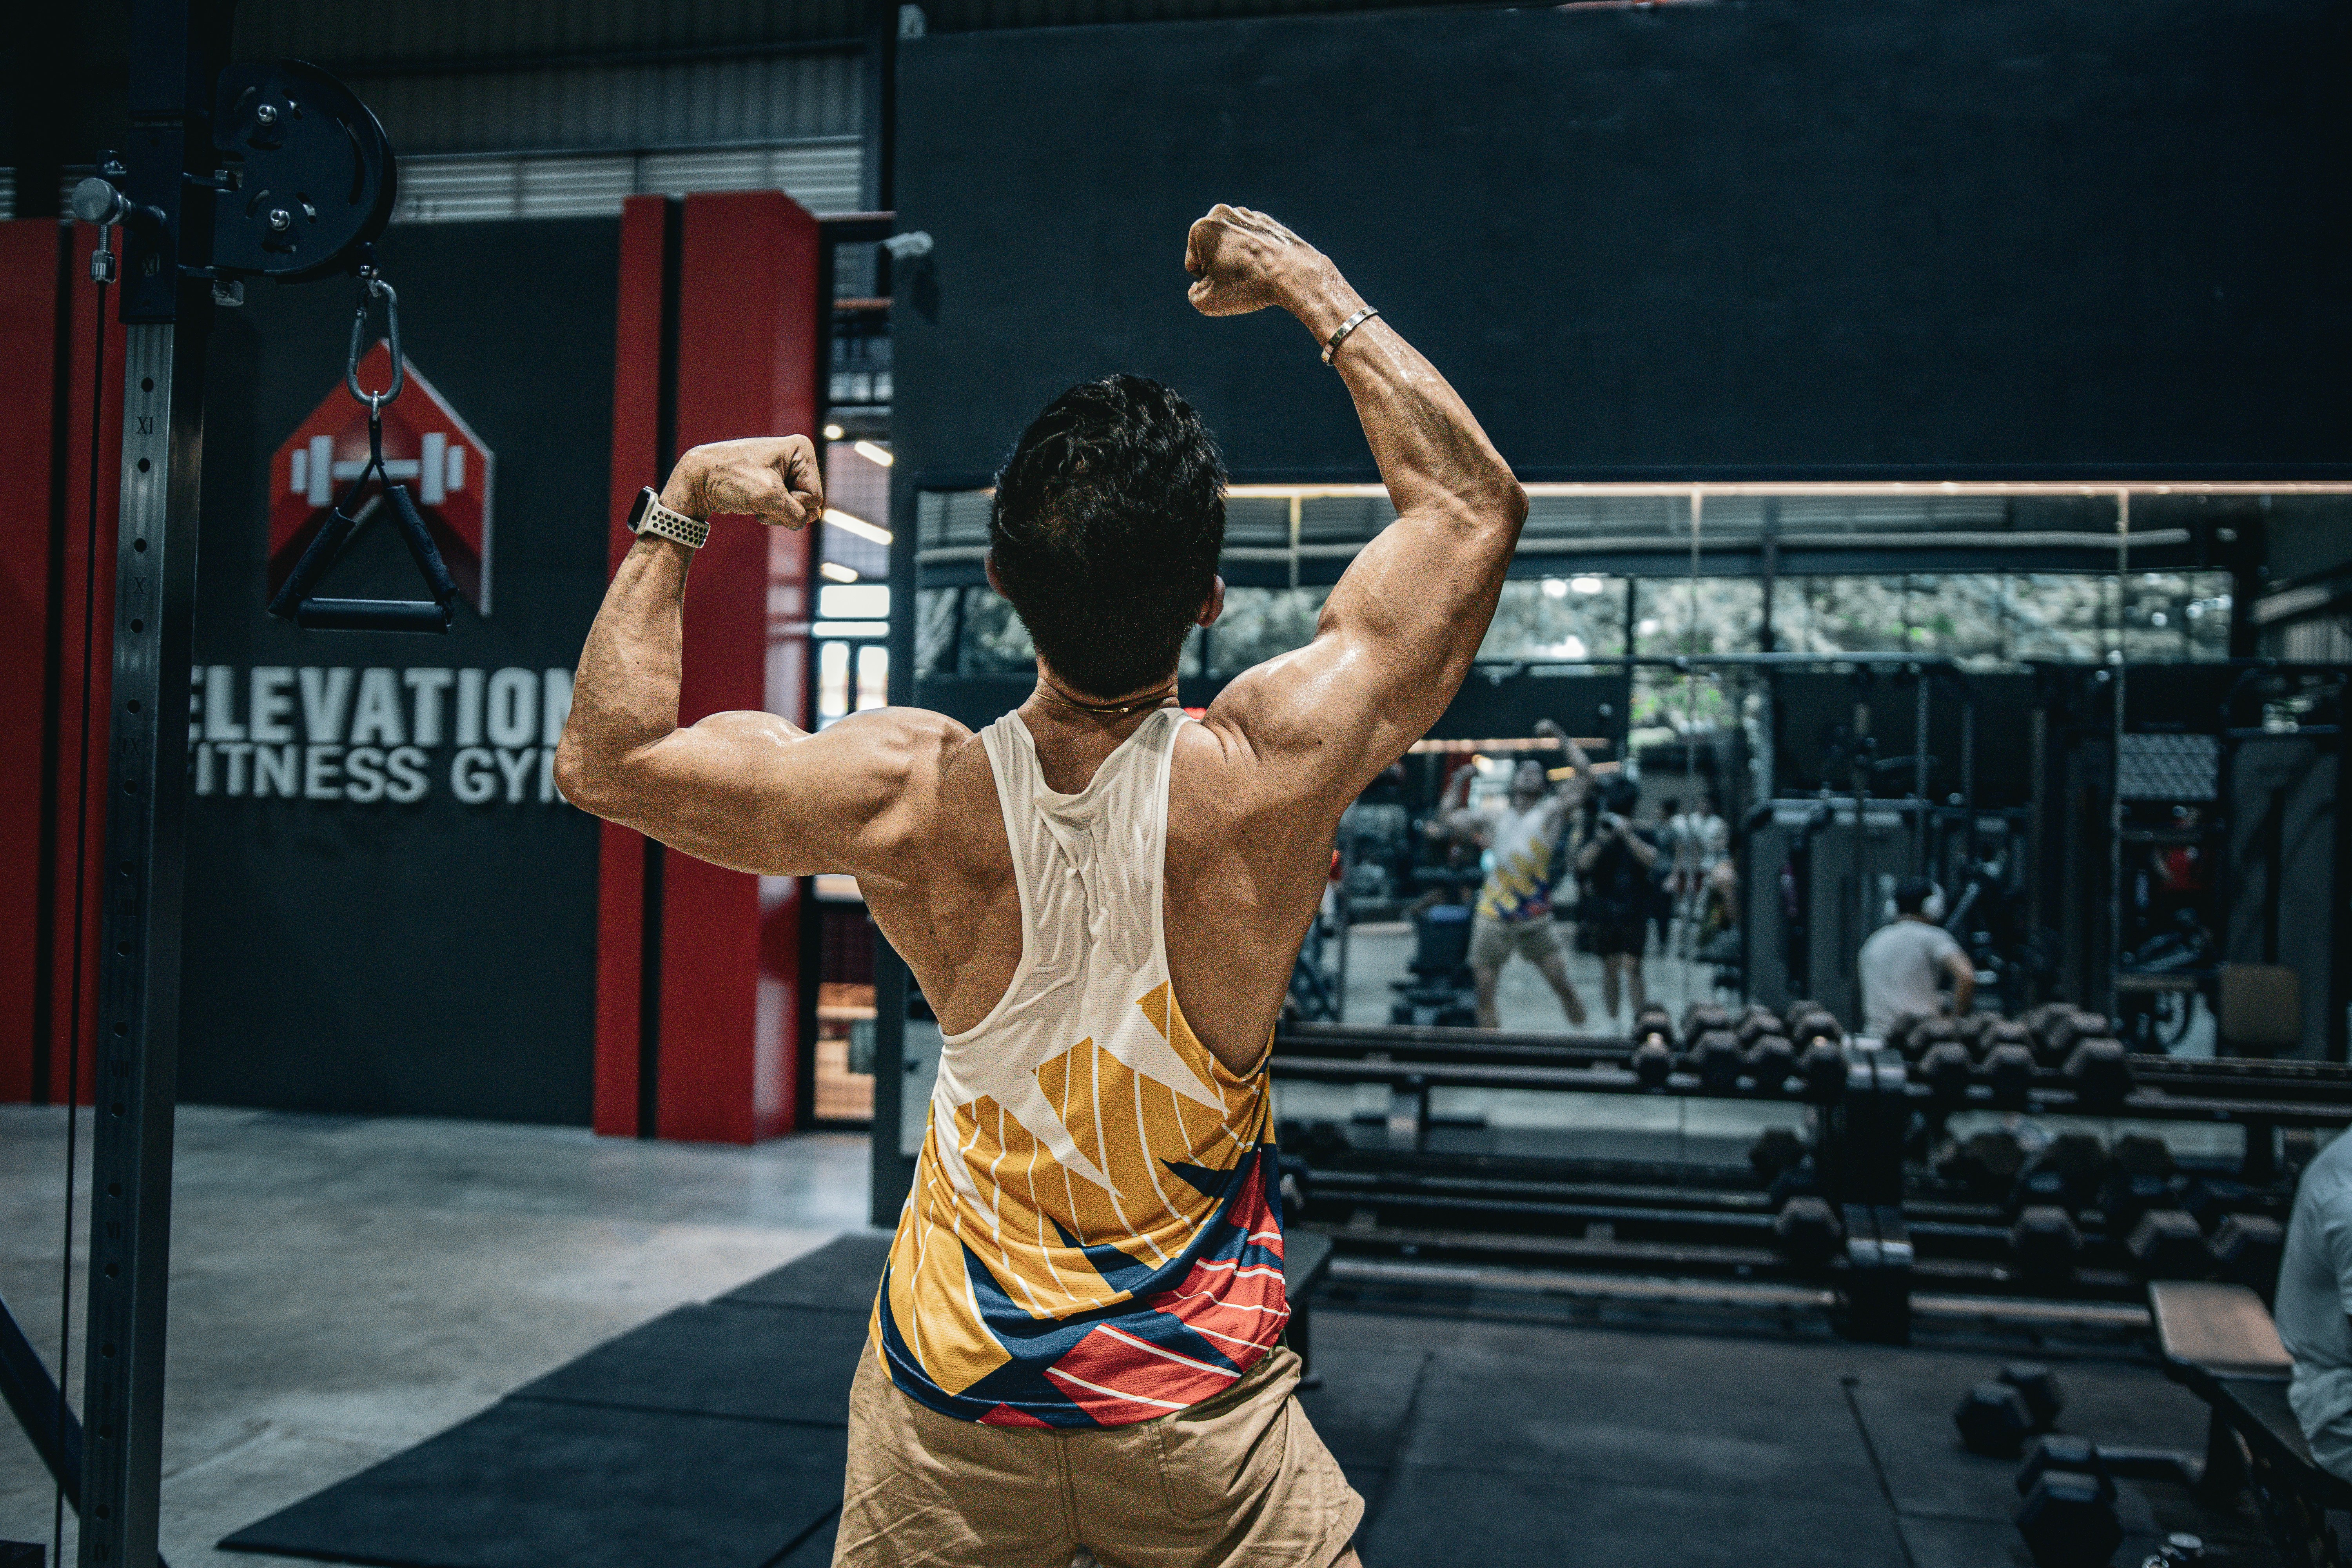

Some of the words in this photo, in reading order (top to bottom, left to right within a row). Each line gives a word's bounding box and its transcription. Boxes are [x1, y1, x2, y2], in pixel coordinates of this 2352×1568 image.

[136, 417, 153, 434] XI
[134, 577, 147, 595] X
[190, 664, 577, 746] LEVATIO
[122, 737, 140, 755] IX
[188, 742, 430, 804] ITNESS
